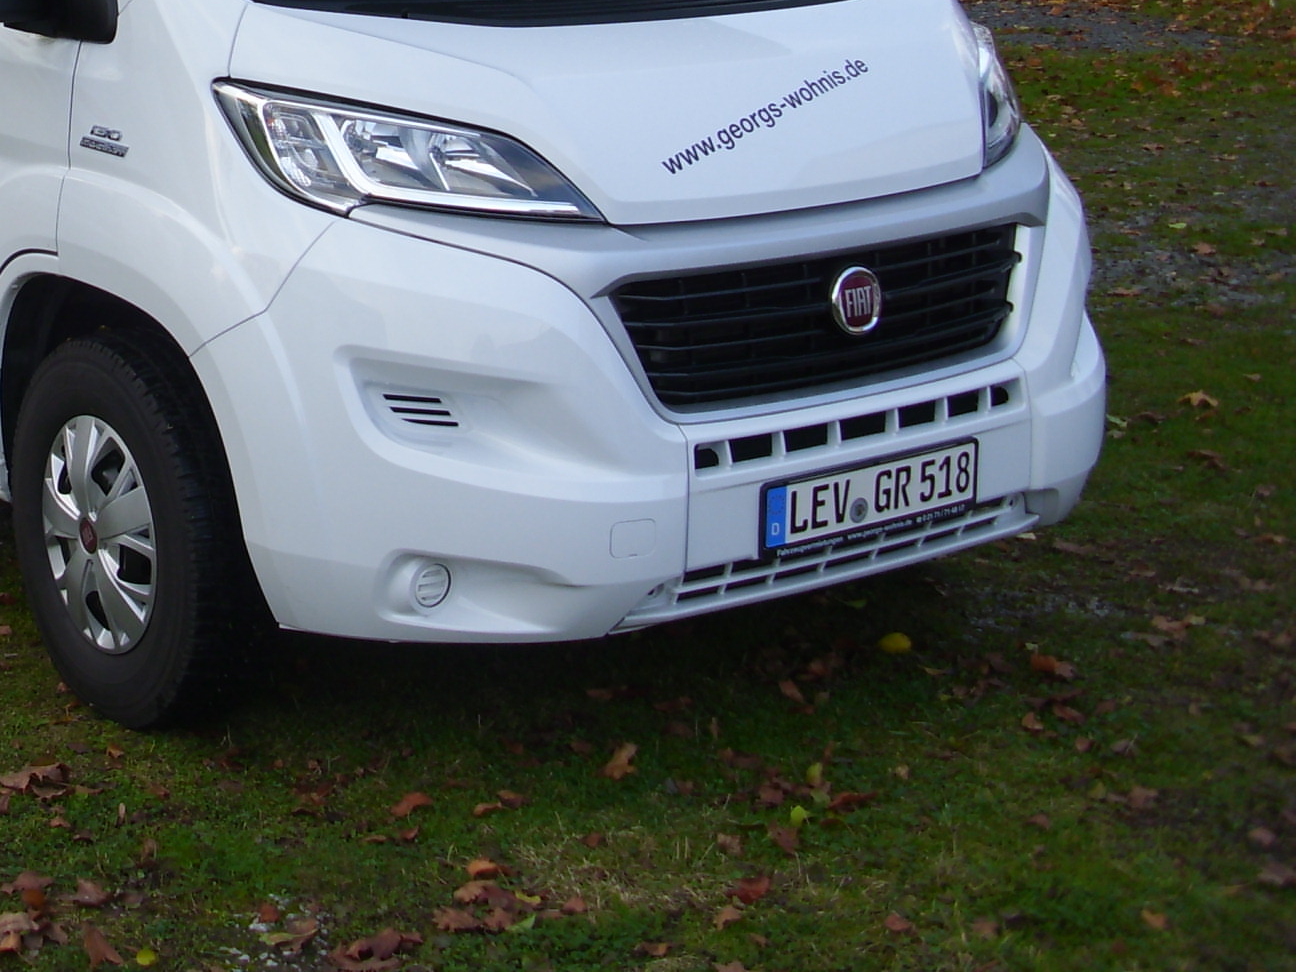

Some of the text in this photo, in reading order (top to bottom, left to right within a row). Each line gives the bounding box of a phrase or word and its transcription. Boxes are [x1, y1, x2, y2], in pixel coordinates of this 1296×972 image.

[662, 59, 869, 175] www.georgs-wohnis.de
[845, 286, 871, 317] FIAT
[771, 451, 970, 536] D LEV GR 518
